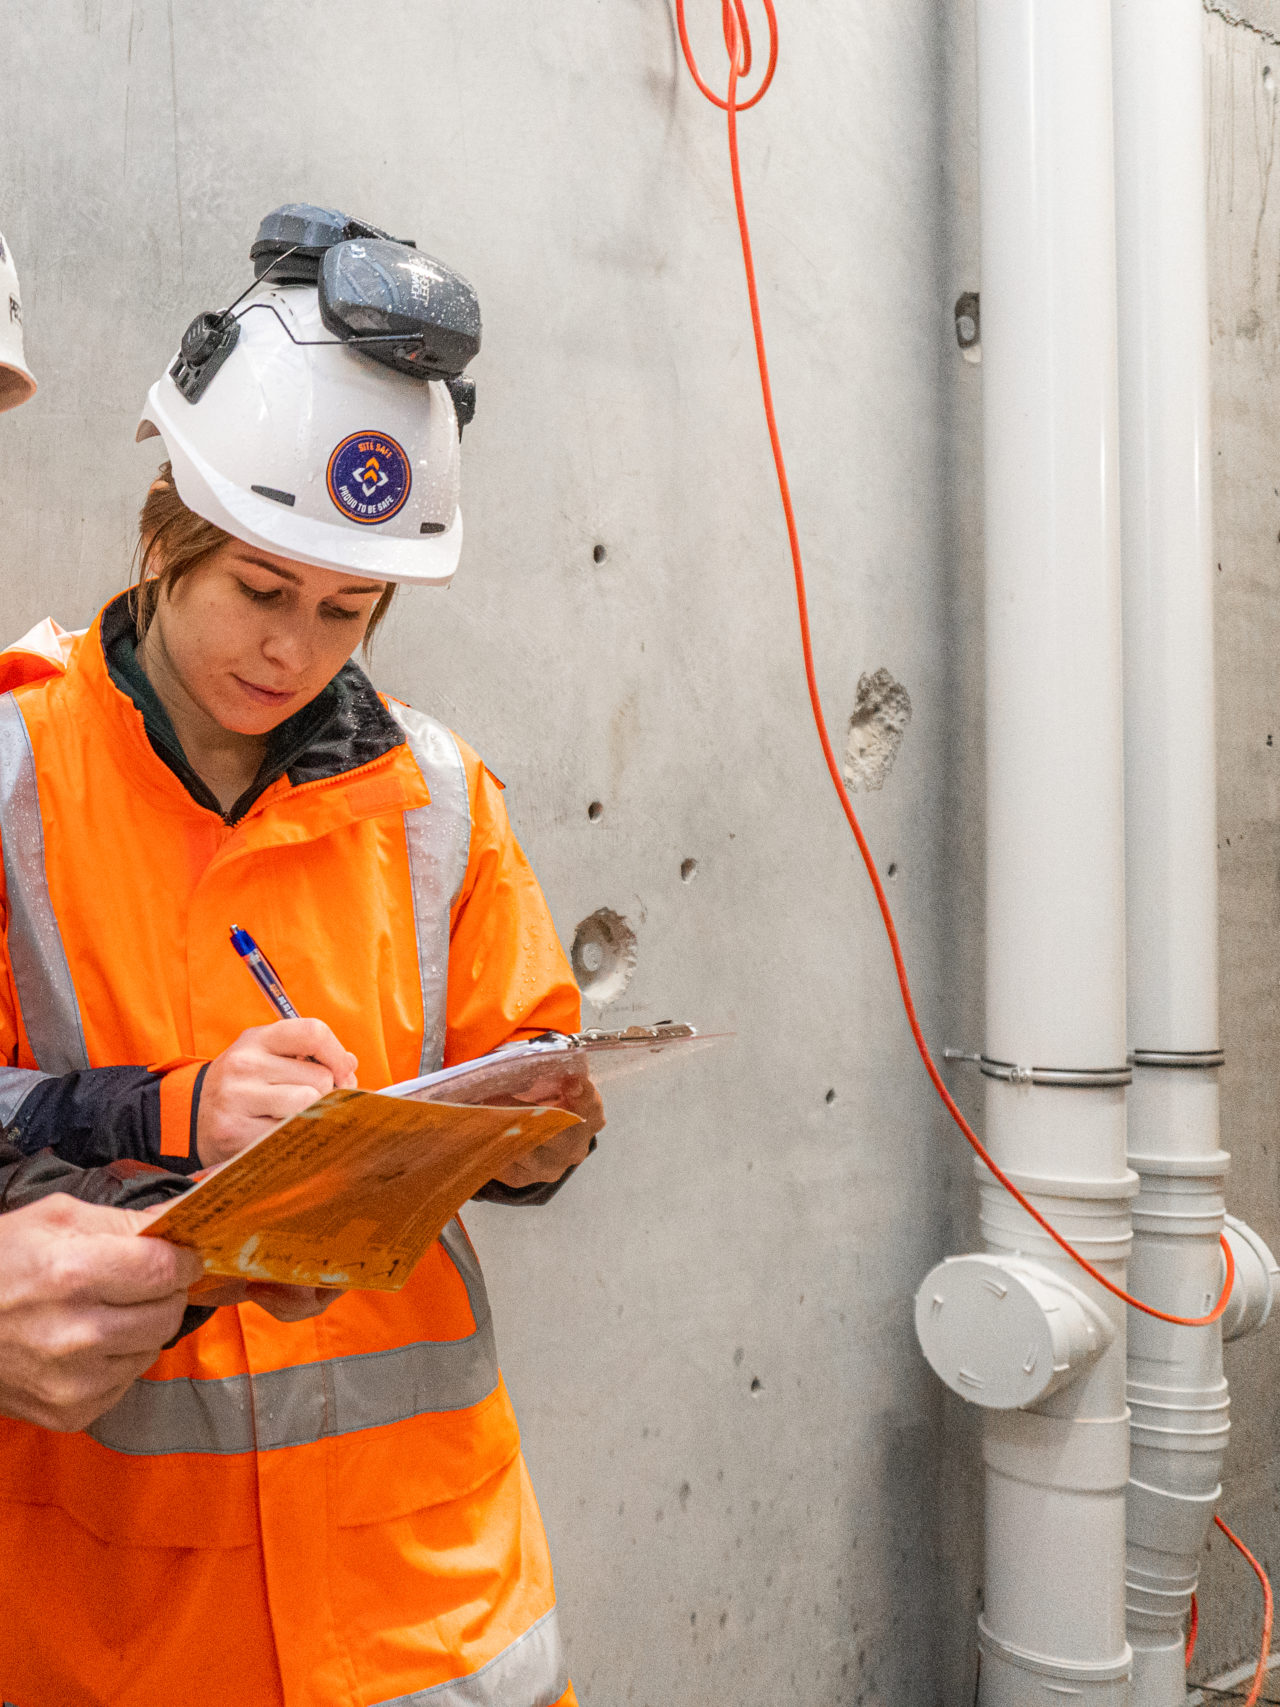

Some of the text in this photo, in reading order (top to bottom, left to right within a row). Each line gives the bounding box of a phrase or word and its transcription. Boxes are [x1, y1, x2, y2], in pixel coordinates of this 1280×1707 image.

[358, 442, 392, 459] SITE SAFE
[339, 485, 394, 514] PROUD TO BE SAFE
